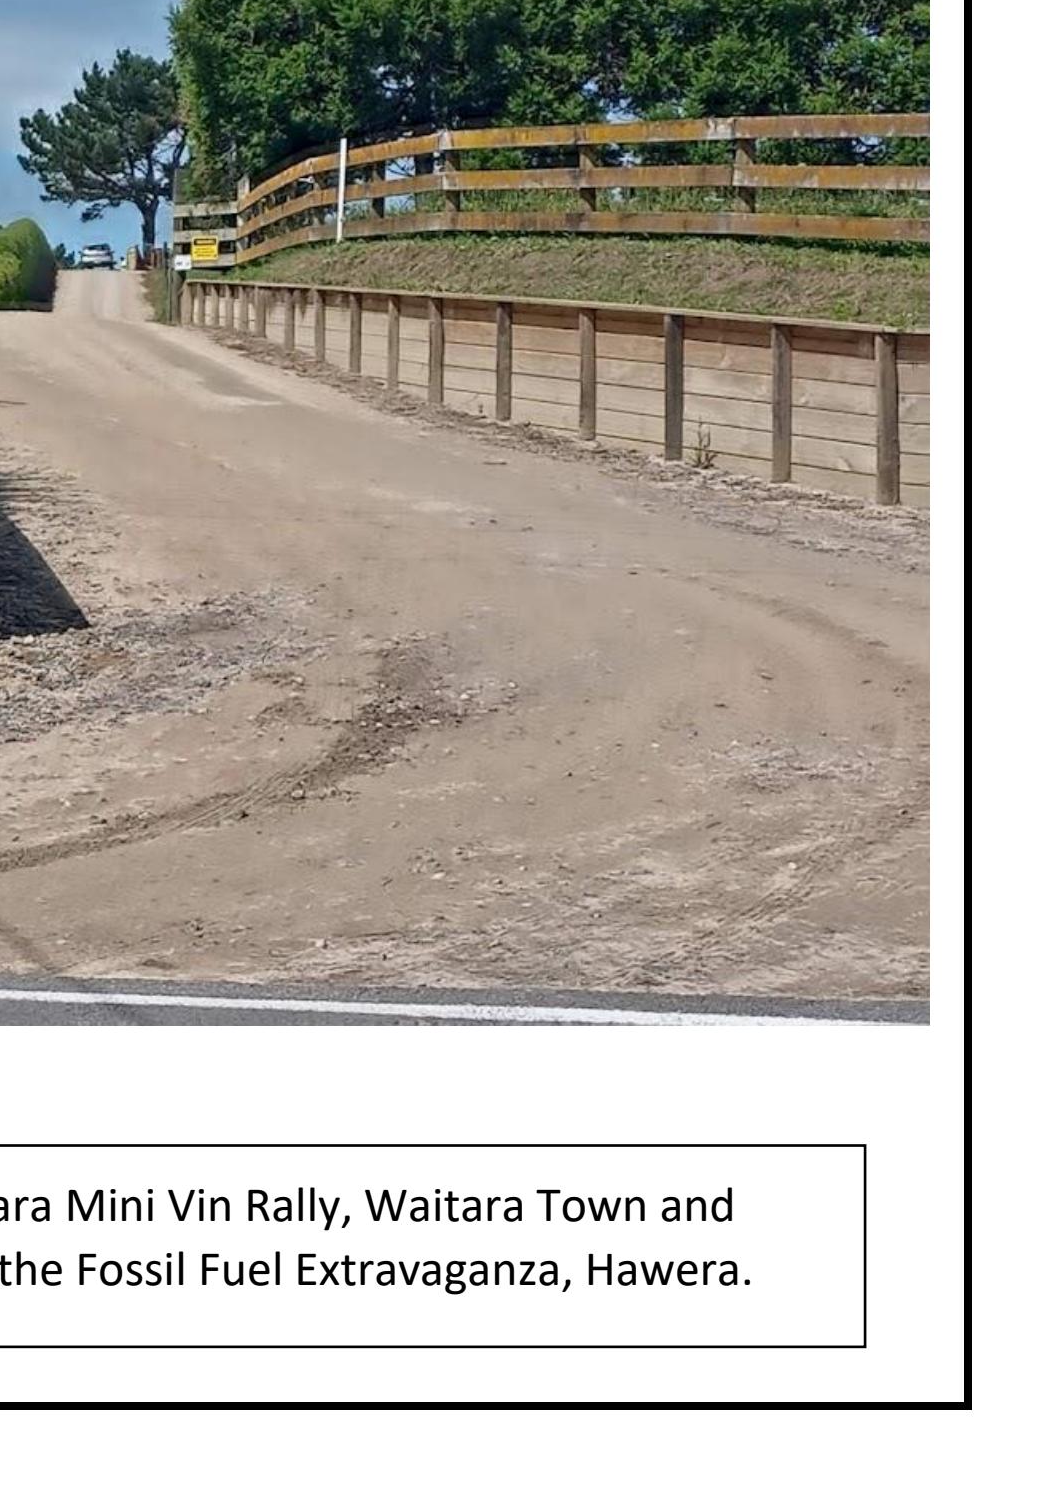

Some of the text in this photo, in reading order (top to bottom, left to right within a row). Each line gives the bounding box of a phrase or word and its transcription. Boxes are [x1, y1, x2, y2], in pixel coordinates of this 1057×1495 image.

[68, 1188, 154, 1222] Mini
[167, 1188, 231, 1222] Vin
[247, 1186, 351, 1231] Rally,
[364, 1188, 523, 1223] Waitara
[536, 1189, 646, 1223] Town
[661, 1186, 733, 1223] and
[78, 1250, 184, 1287] Fossil
[201, 1250, 281, 1287] Fuel
[297, 1253, 571, 1295] Extravaganza,
[588, 1253, 751, 1287] Hawera.
